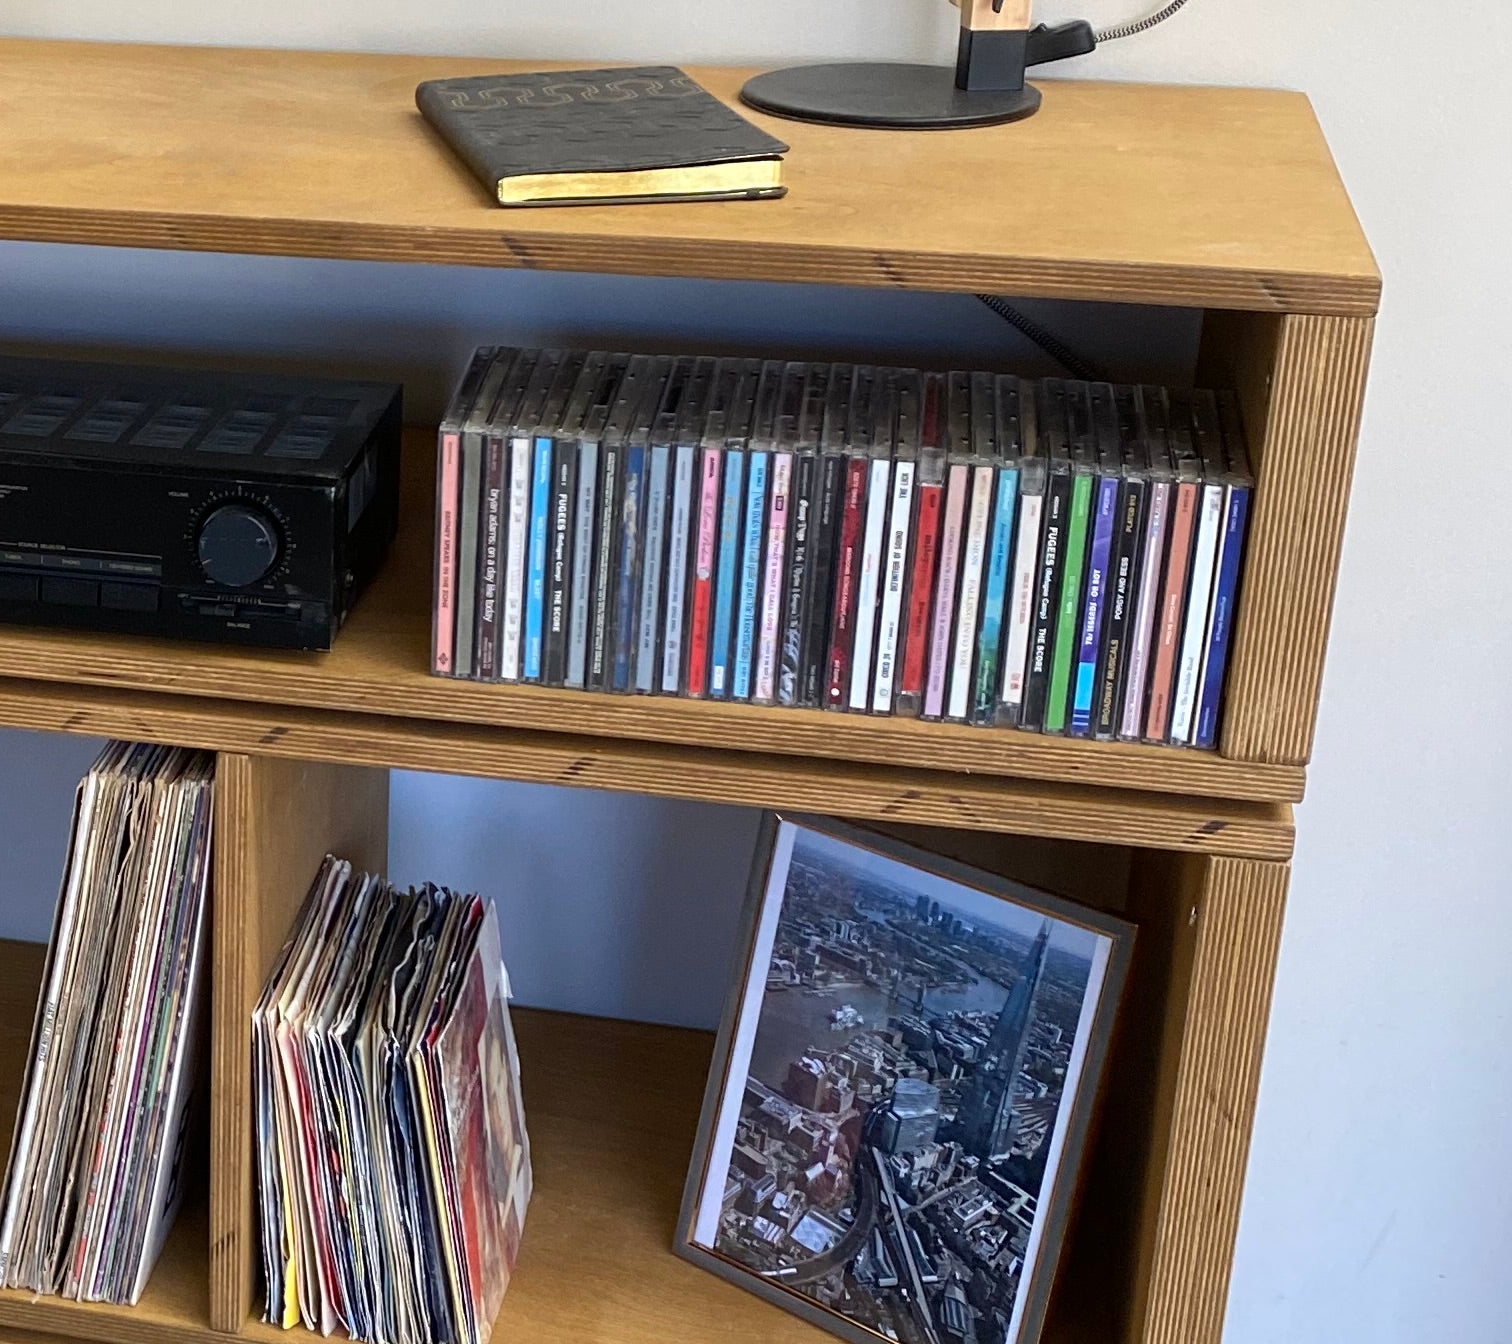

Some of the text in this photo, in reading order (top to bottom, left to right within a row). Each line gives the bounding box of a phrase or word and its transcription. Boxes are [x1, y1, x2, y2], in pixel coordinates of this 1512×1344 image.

[487, 488, 499, 512] bryan
[556, 493, 567, 530] FUGEES
[487, 514, 498, 545] adams:
[487, 546, 494, 558] on
[1044, 526, 1058, 566] FUGEES
[484, 566, 495, 582] day
[1119, 556, 1129, 576] BESS
[485, 583, 494, 597] like
[553, 590, 561, 604] THE
[1117, 577, 1126, 593] AND
[482, 599, 494, 622] today
[552, 606, 560, 632] SCORE
[1114, 594, 1125, 620] PORGY
[1037, 627, 1046, 644] THE
[1033, 645, 1044, 672] SCORE
[1106, 638, 1119, 679] MUSICALS
[1100, 680, 1114, 725] BROADWAY
